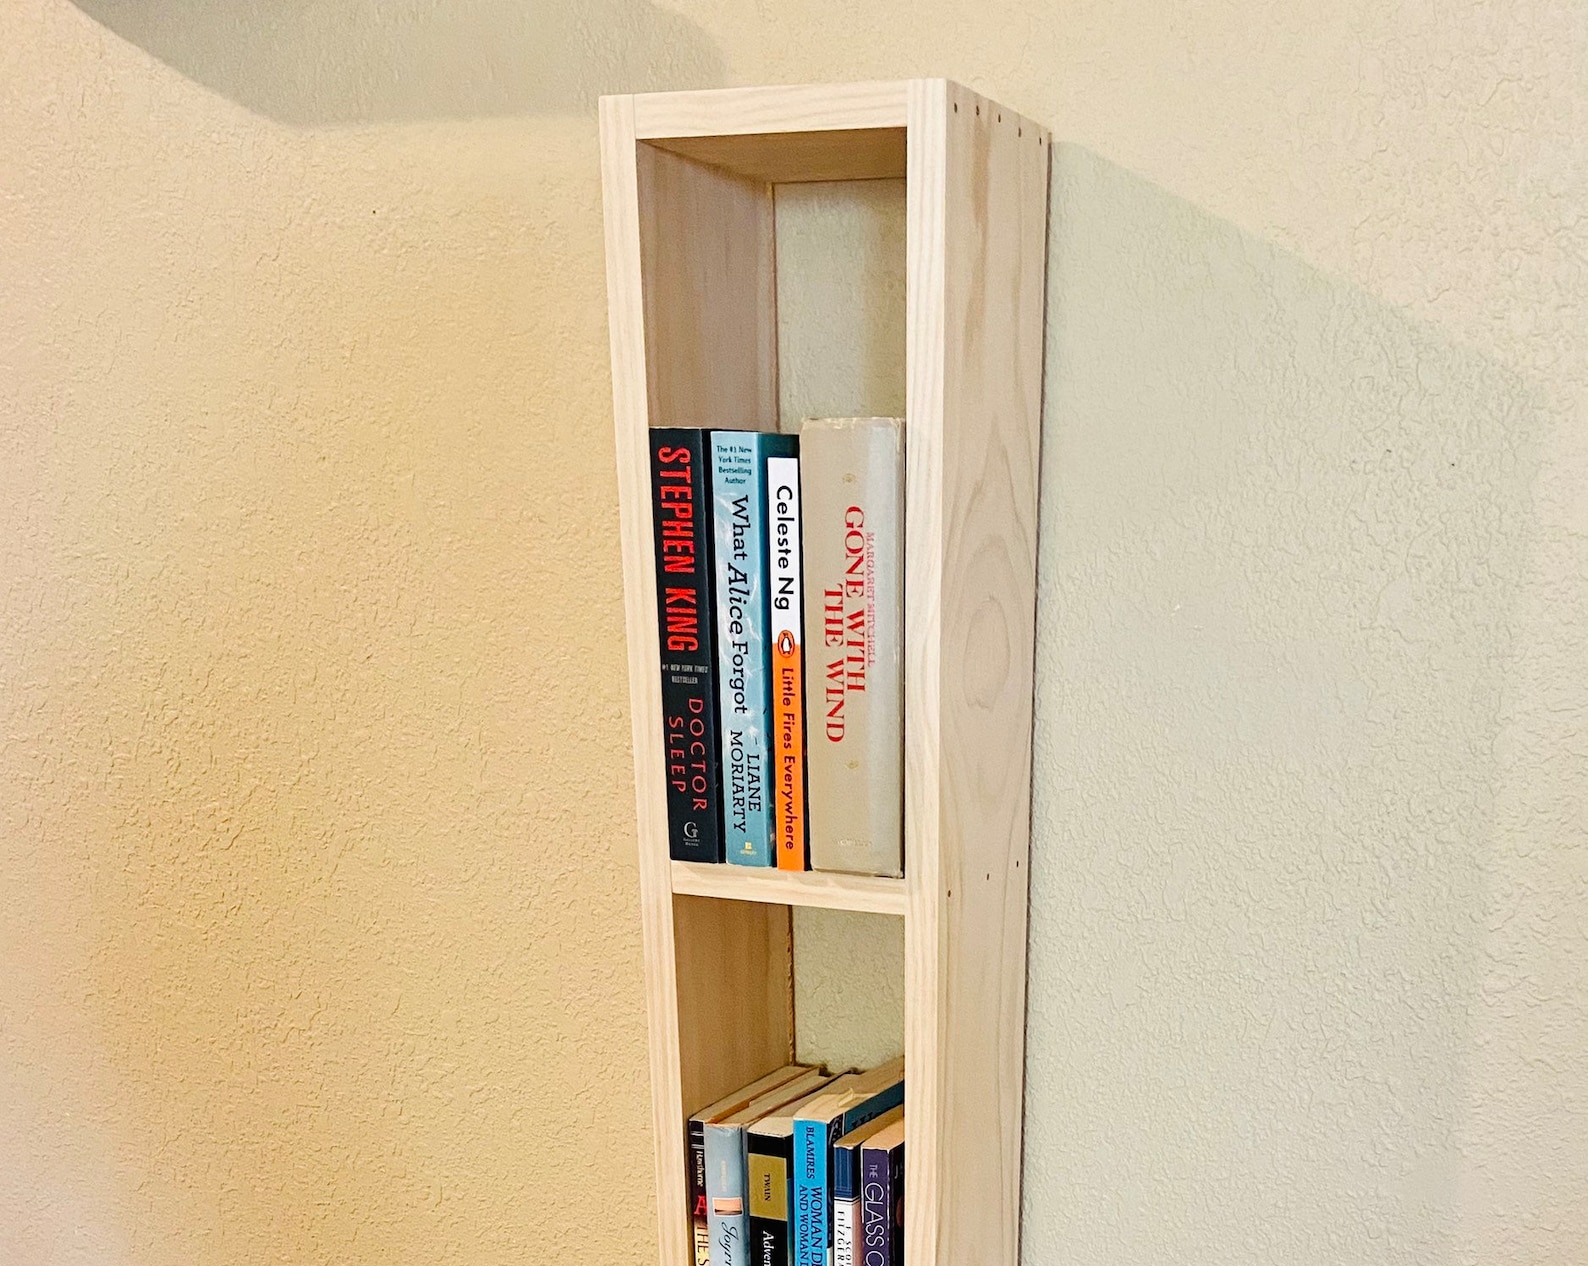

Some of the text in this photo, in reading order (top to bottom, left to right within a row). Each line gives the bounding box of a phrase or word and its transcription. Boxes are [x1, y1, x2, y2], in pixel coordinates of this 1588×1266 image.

[717, 445, 728, 453] The
[718, 466, 752, 475] Bestselling
[734, 456, 751, 464] Times
[657, 446, 699, 652] STEPHEN KING
[775, 485, 795, 611] Celeste Ng
[727, 494, 750, 714] What Alice Forgot
[844, 505, 865, 692] GONE WITH
[824, 583, 845, 743] THE WIND
[668, 716, 686, 793] SLEEP
[688, 697, 708, 811] DOCTOR
[730, 730, 746, 834] MORIARTY
[747, 753, 761, 813] LIANE
[781, 668, 797, 850] Little Fires Everywhere
[806, 1126, 815, 1180] BLAMIRES
[869, 1164, 878, 1178] THE
[799, 1184, 809, 1211] AND
[810, 1185, 823, 1250] WOMAN
[864, 1182, 885, 1247] GLASS
[800, 1213, 809, 1260] WOMAN
